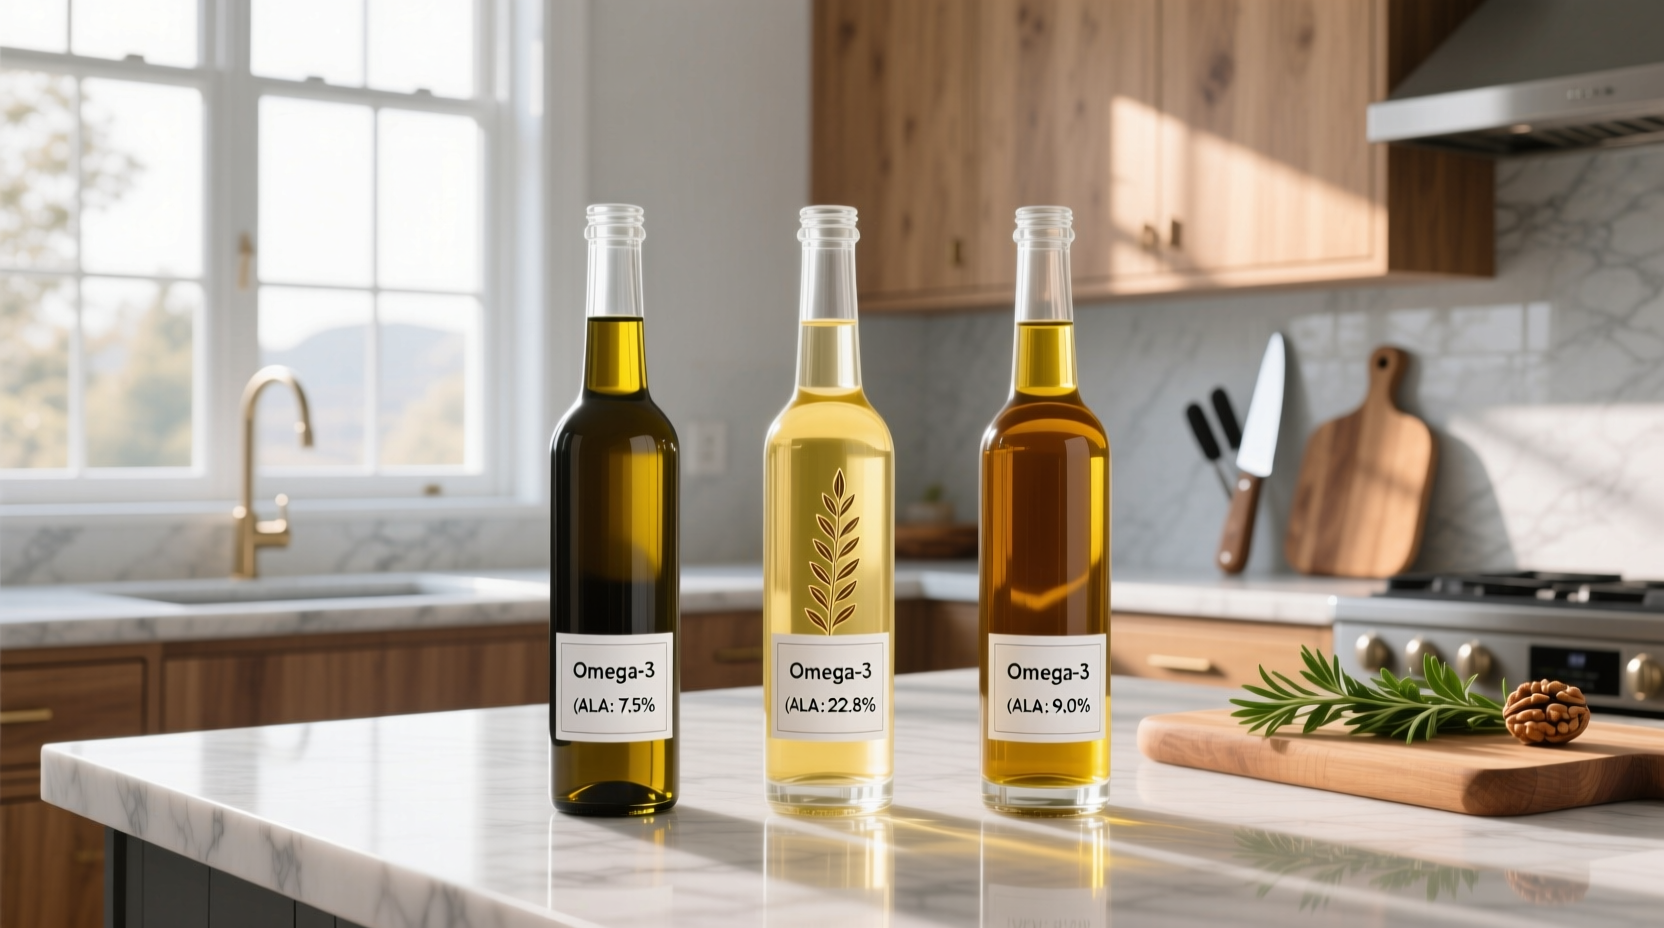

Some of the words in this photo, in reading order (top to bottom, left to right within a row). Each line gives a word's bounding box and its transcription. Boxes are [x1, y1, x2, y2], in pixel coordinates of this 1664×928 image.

[573, 661, 656, 684] Omega-3
[789, 662, 872, 685] Omega-3
[1007, 662, 1090, 685] Omega-3
[573, 697, 614, 715] (ALA:
[618, 697, 656, 714] 7.5%
[785, 696, 825, 715] (ALA:
[827, 696, 876, 713] 22.8%
[1007, 698, 1049, 715] (ALA:
[1052, 697, 1091, 714] 9.0%
